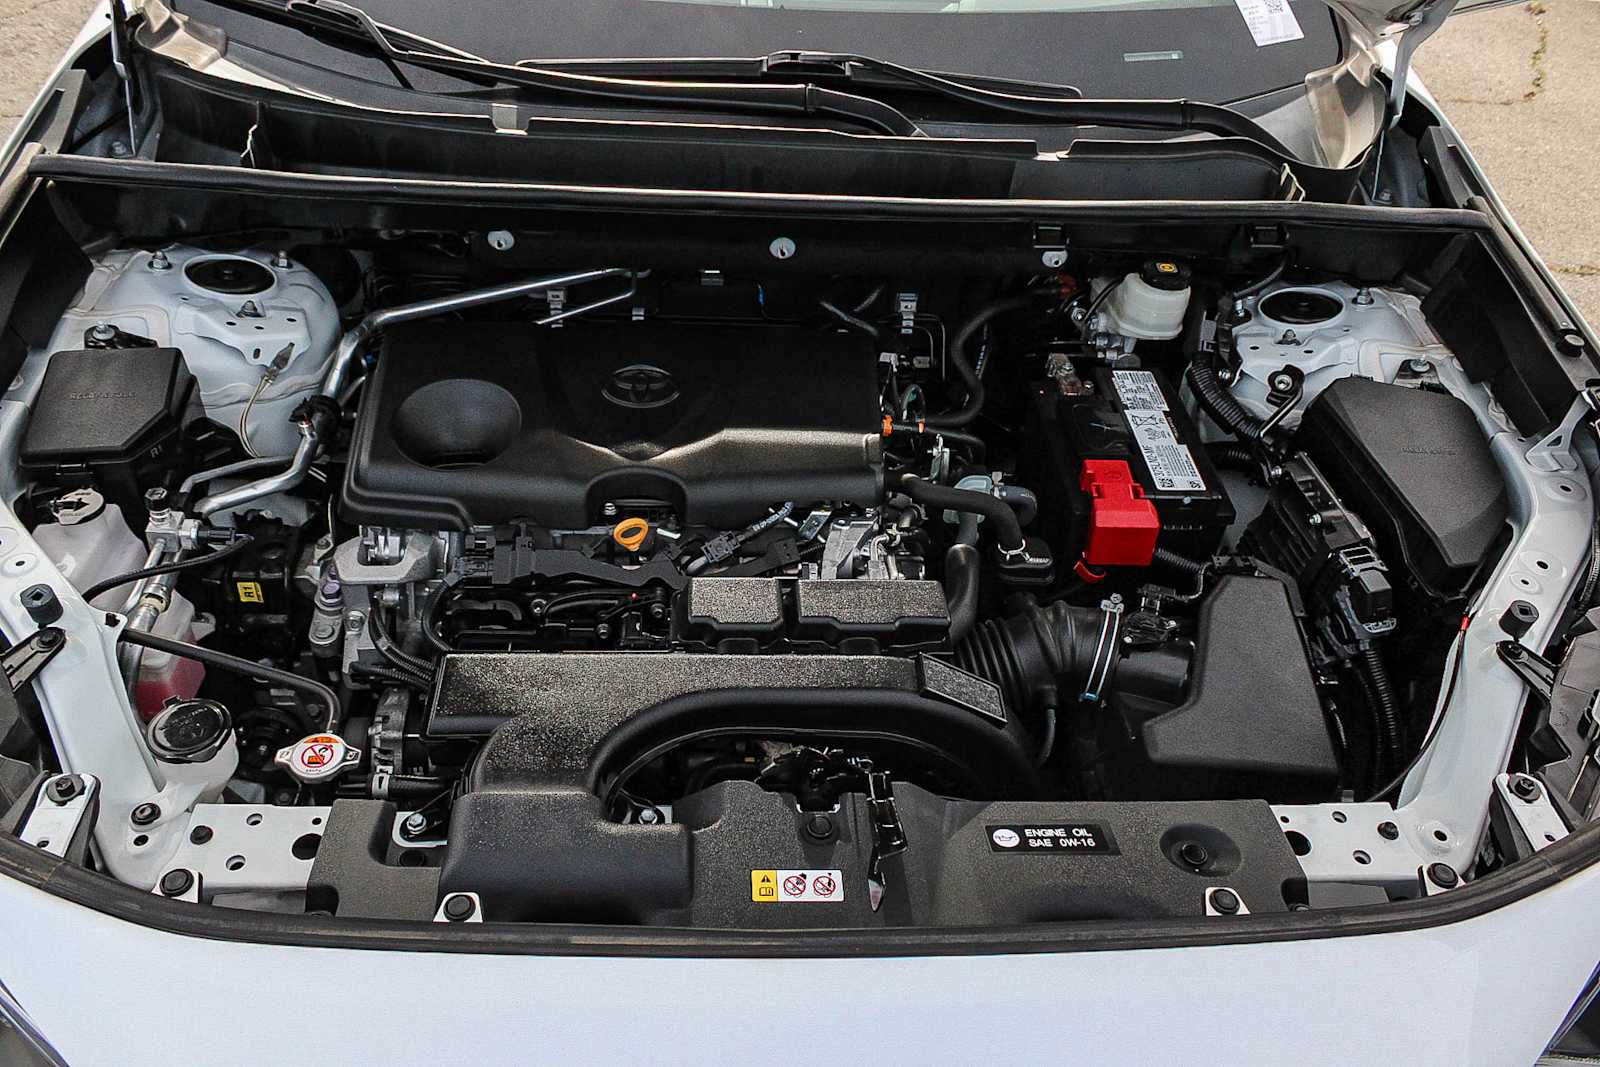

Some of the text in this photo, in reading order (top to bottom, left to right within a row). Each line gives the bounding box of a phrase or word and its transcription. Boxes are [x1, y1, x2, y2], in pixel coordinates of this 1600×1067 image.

[1024, 828, 1093, 837] ENGINE OIL
[1028, 838, 1096, 848] SAE 0W-16
